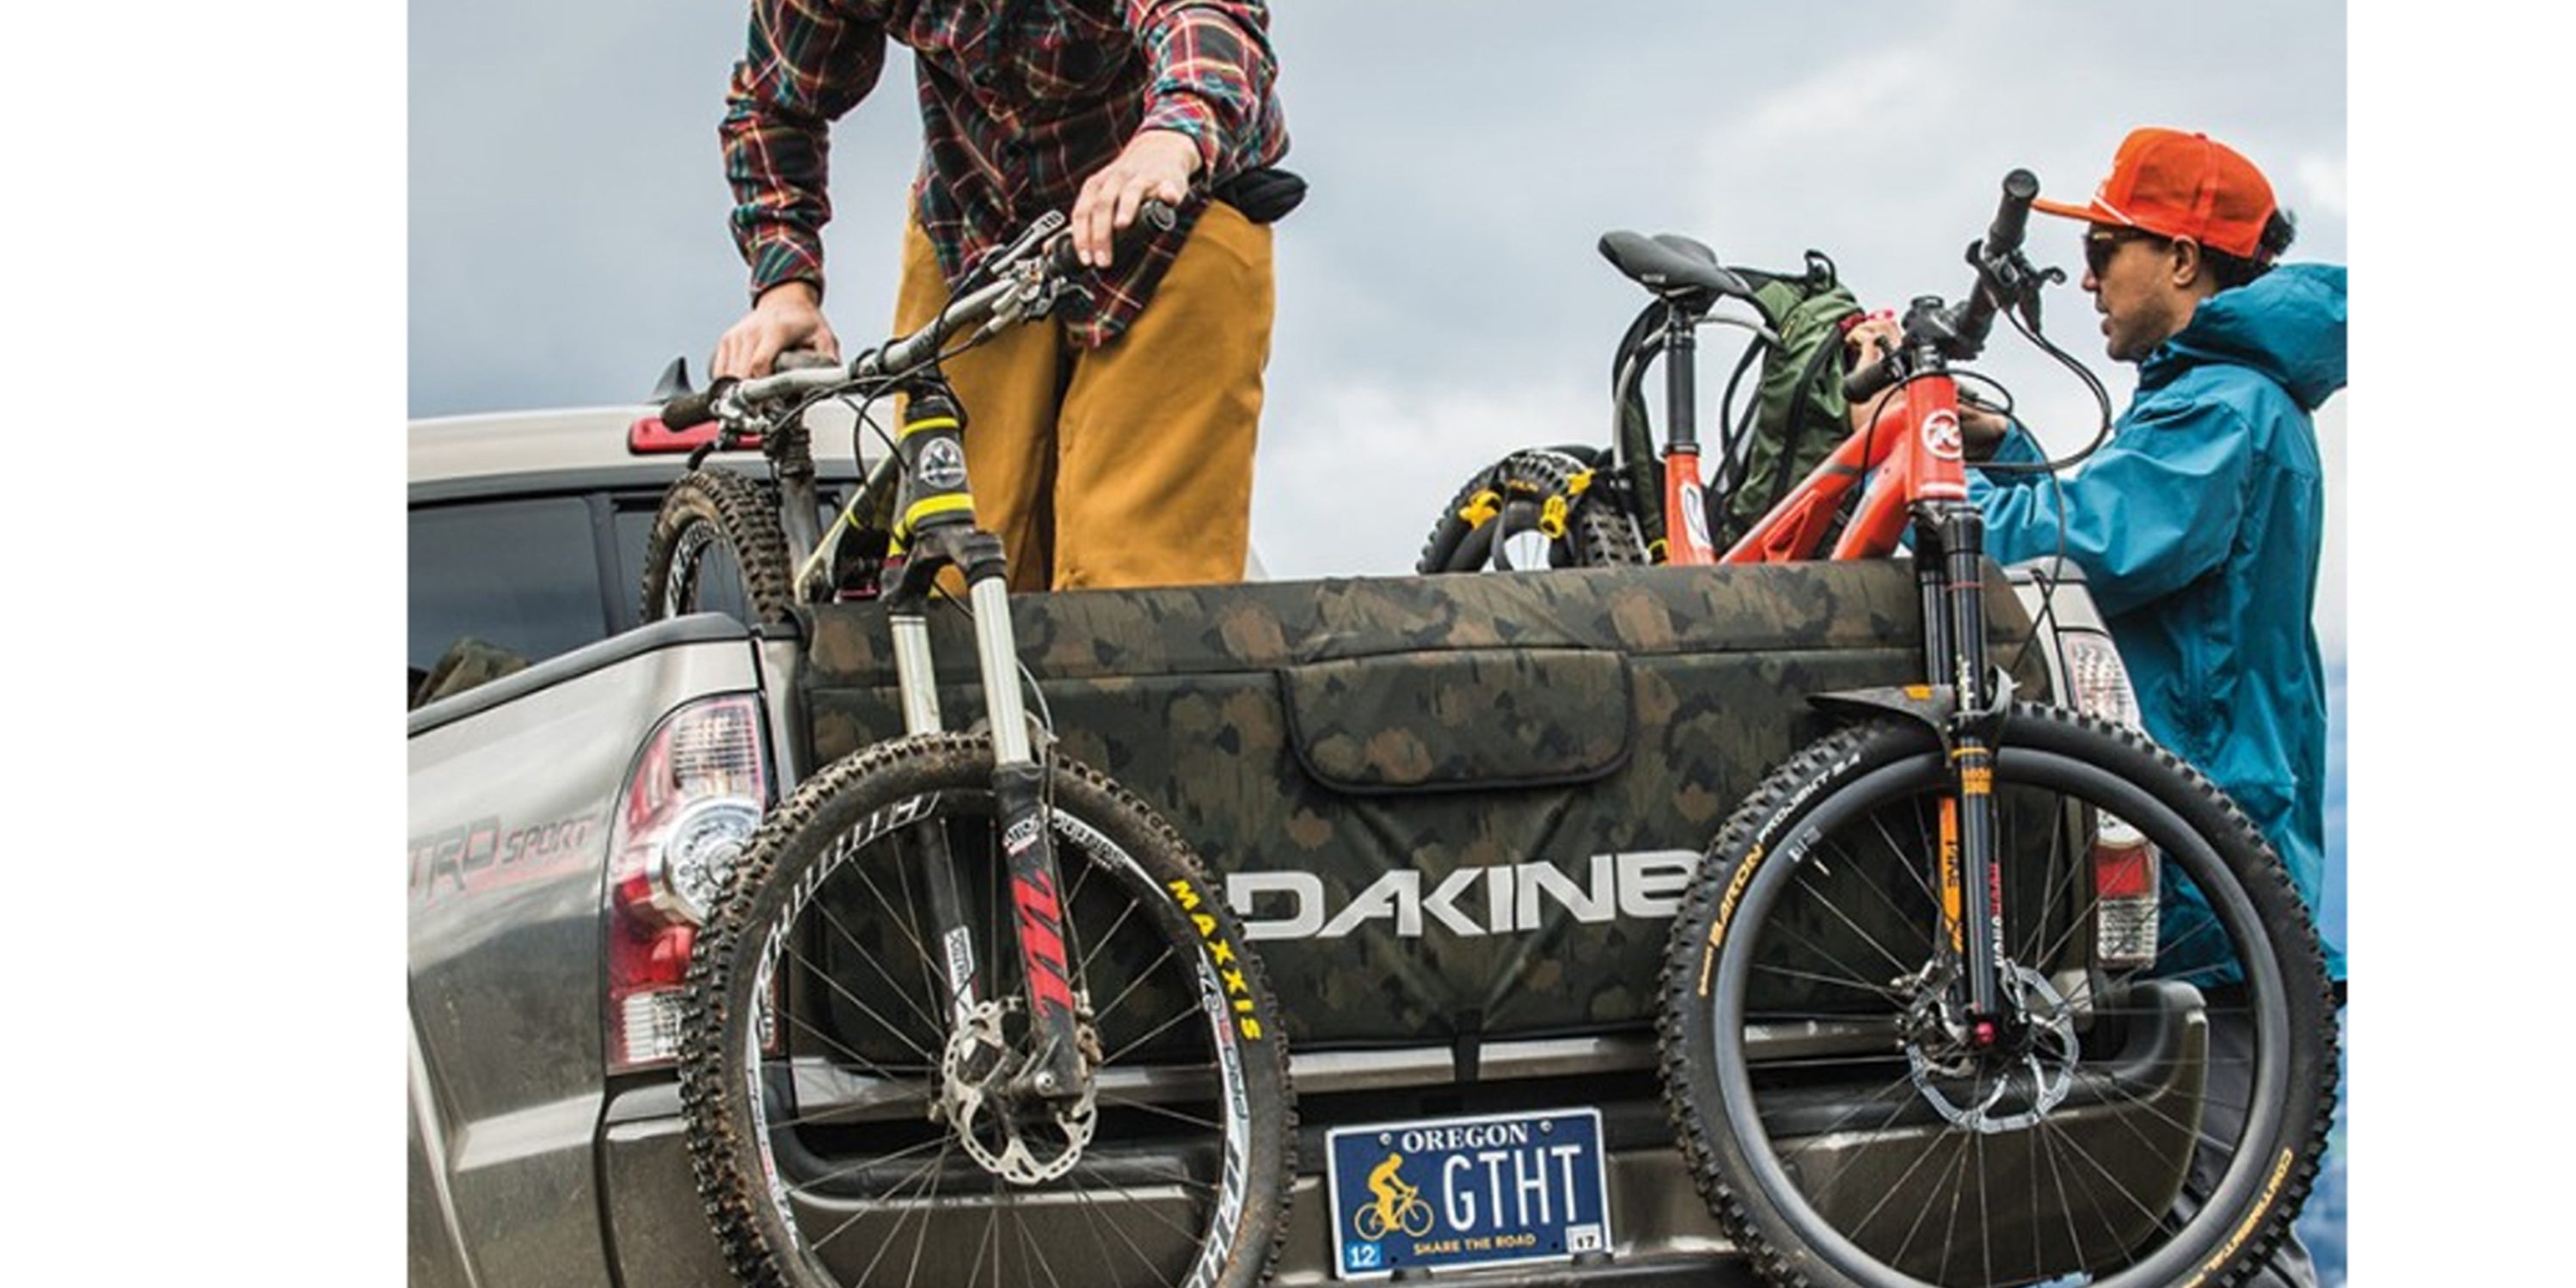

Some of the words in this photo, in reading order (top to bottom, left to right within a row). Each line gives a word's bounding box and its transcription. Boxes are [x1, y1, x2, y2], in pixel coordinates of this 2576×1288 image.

[1227, 849, 1703, 941] DAKINE
[1168, 880, 1262, 1040] MAXXIS
[1401, 1121, 1529, 1153] OREGON
[1443, 1144, 1582, 1232] GTHT
[1348, 1246, 1377, 1267] 12
[1413, 1240, 1461, 1256] SHARE
[1464, 1237, 1493, 1251] THE
[1494, 1233, 1537, 1248] ROAD
